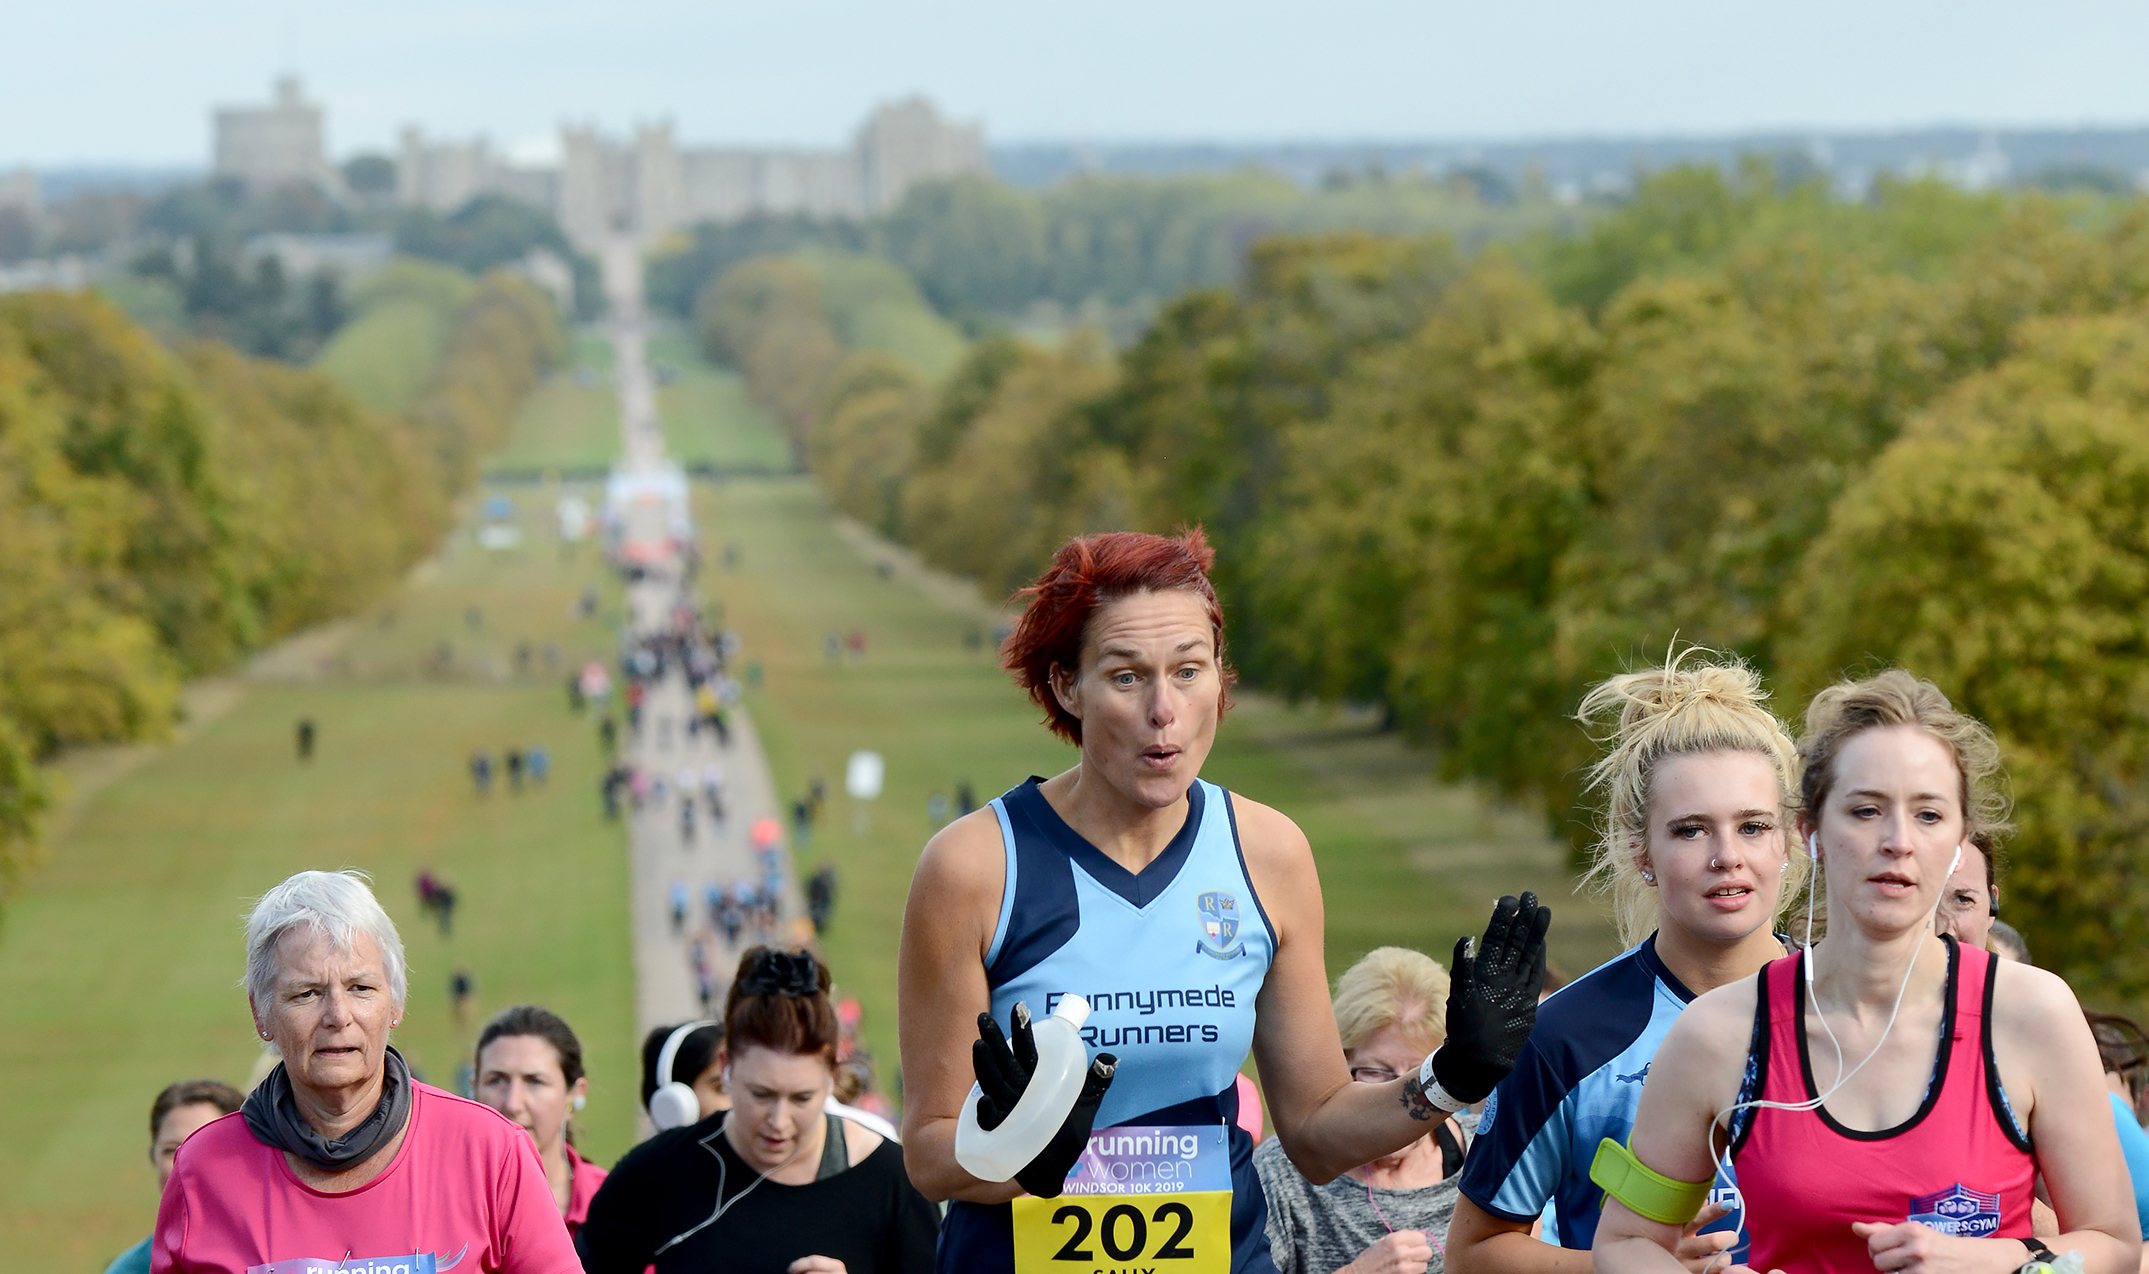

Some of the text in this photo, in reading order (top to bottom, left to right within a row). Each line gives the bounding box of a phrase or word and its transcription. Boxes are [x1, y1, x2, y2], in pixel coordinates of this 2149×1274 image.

[1204, 896, 1216, 911] R
[1222, 921, 1233, 937] R
[1046, 984, 1236, 1015] Rnnymede
[1078, 1024, 1219, 1048] Runners
[1086, 1130, 1198, 1159] running
[1087, 1160, 1193, 1181] women
[1062, 1181, 1185, 1194] WINDSOR 10K 2019
[1051, 1202, 1195, 1262] 202
[1923, 1217, 1997, 1233] OWERSGYM
